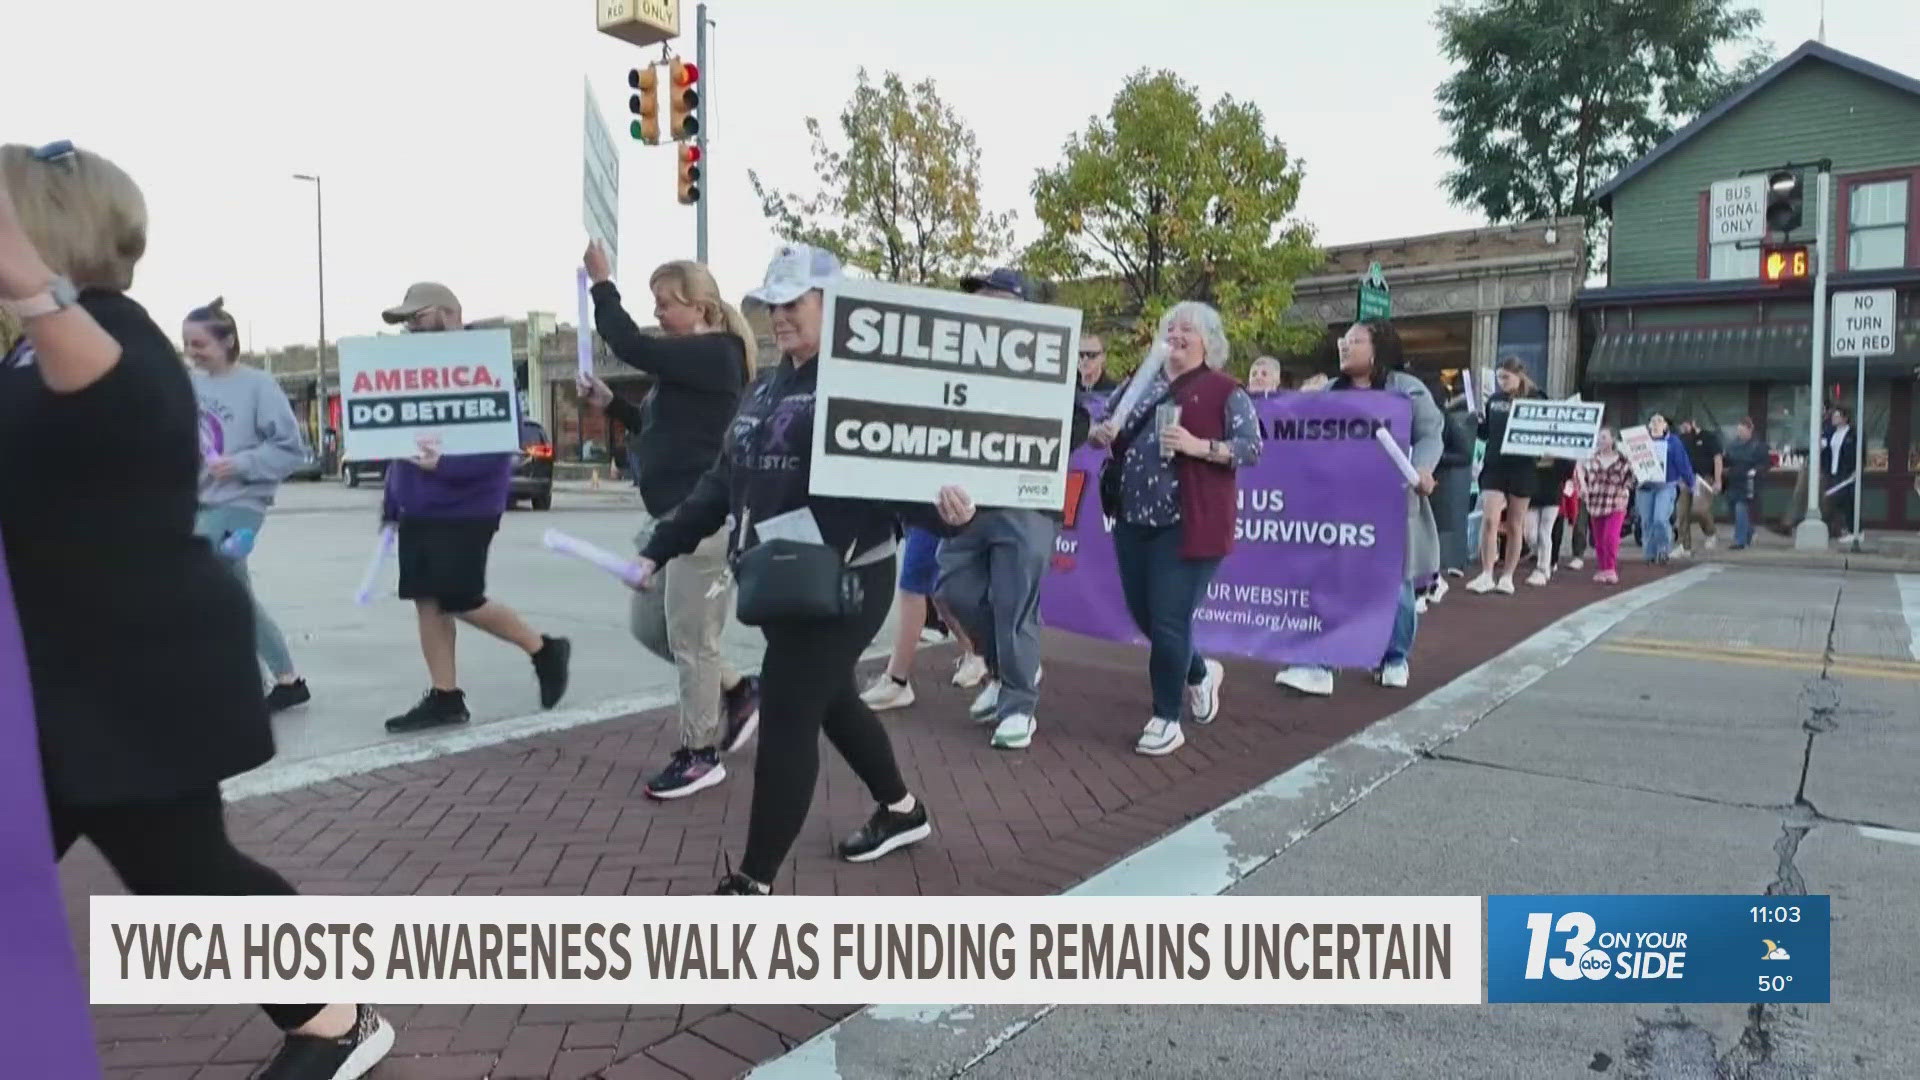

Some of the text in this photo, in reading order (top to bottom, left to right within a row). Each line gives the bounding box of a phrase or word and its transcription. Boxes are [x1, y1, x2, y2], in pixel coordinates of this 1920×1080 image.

[642, 1, 673, 24] ONLY
[1725, 186, 1752, 201] BUS
[1715, 201, 1761, 219] SIGNAL
[1721, 219, 1754, 234] ONLY
[1793, 252, 1805, 276] 6
[1854, 296, 1874, 309] NO
[1846, 317, 1882, 331] TURN
[846, 307, 1062, 375] SILENCE
[1836, 336, 1890, 351] ON RED
[352, 365, 501, 393] AMERICA,
[943, 382, 968, 406] IS
[352, 398, 506, 425] DO BETTER.
[1518, 406, 1596, 422] SILENCE
[1273, 418, 1391, 440] MISSION
[1511, 432, 1593, 448] COMPLICITY
[834, 419, 1061, 466] COMPLICITY
[1252, 490, 1284, 512] US
[1234, 518, 1376, 548] SURVIVORS
[1055, 535, 1078, 554] for
[1206, 582, 1310, 609] UR WEBSITE
[1192, 607, 1324, 633] cawcmi.org/walk
